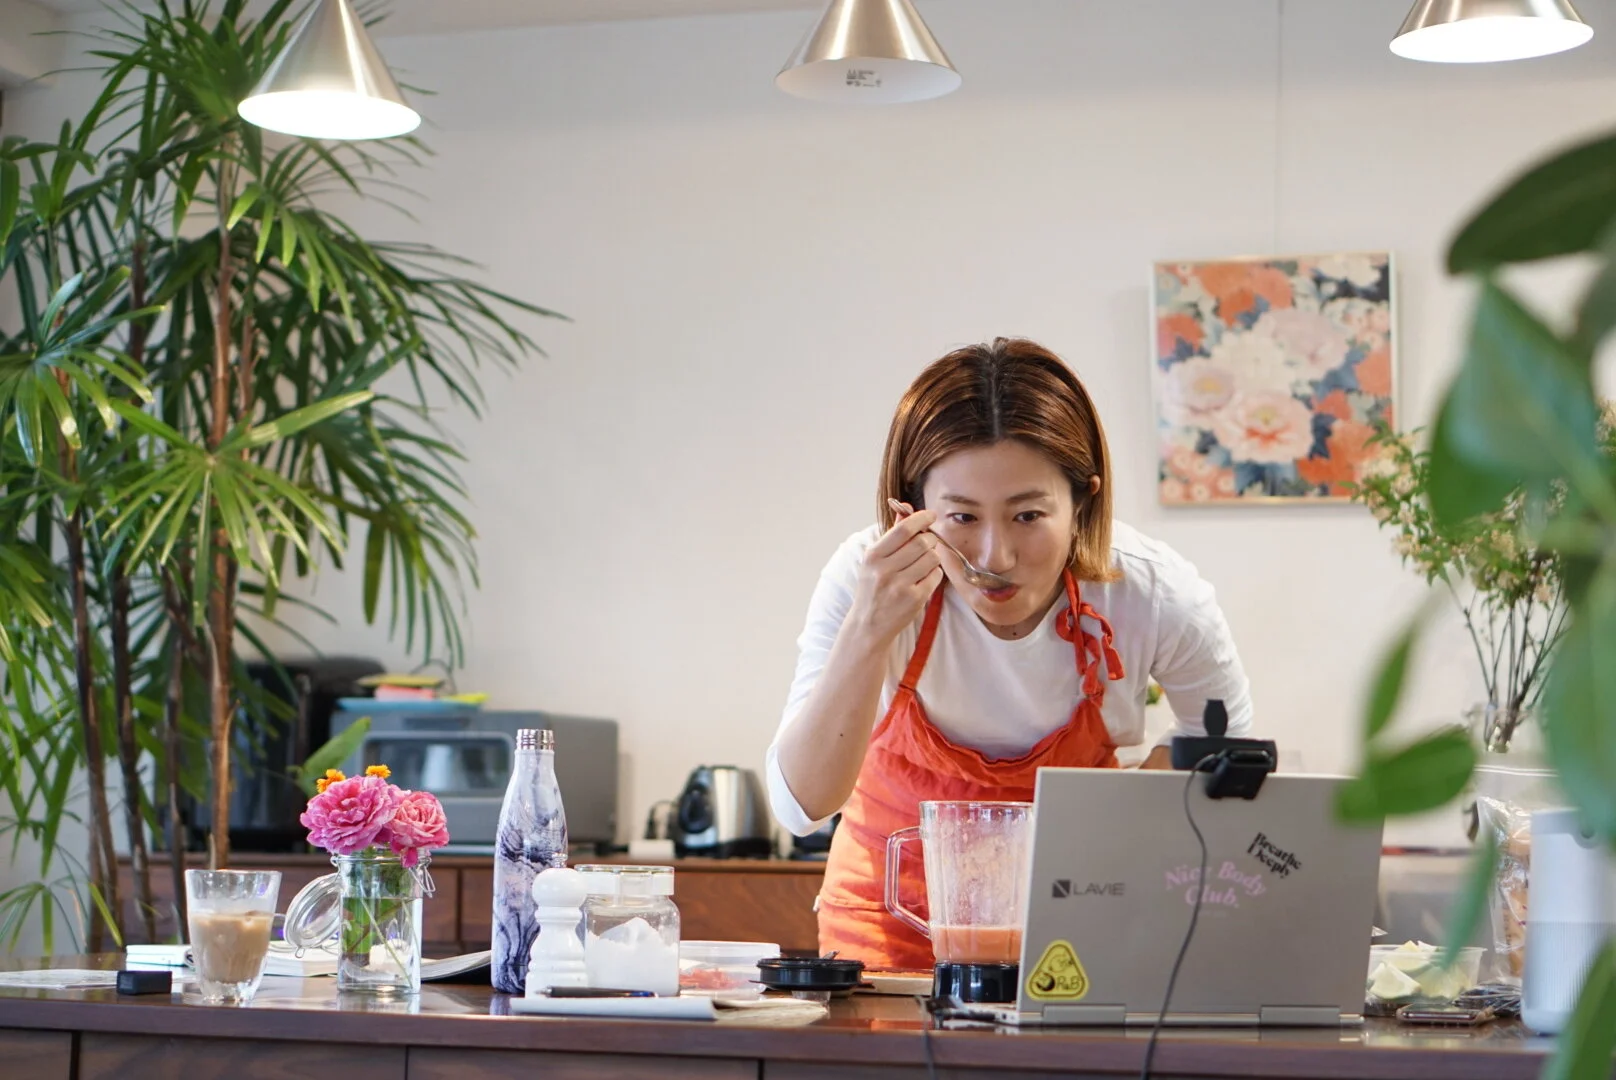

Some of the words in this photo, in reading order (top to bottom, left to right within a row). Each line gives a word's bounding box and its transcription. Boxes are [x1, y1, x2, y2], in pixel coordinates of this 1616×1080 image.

[1254, 832, 1302, 870] Breathe
[1073, 882, 1125, 896] LAVIE
[1217, 861, 1267, 897] Body
